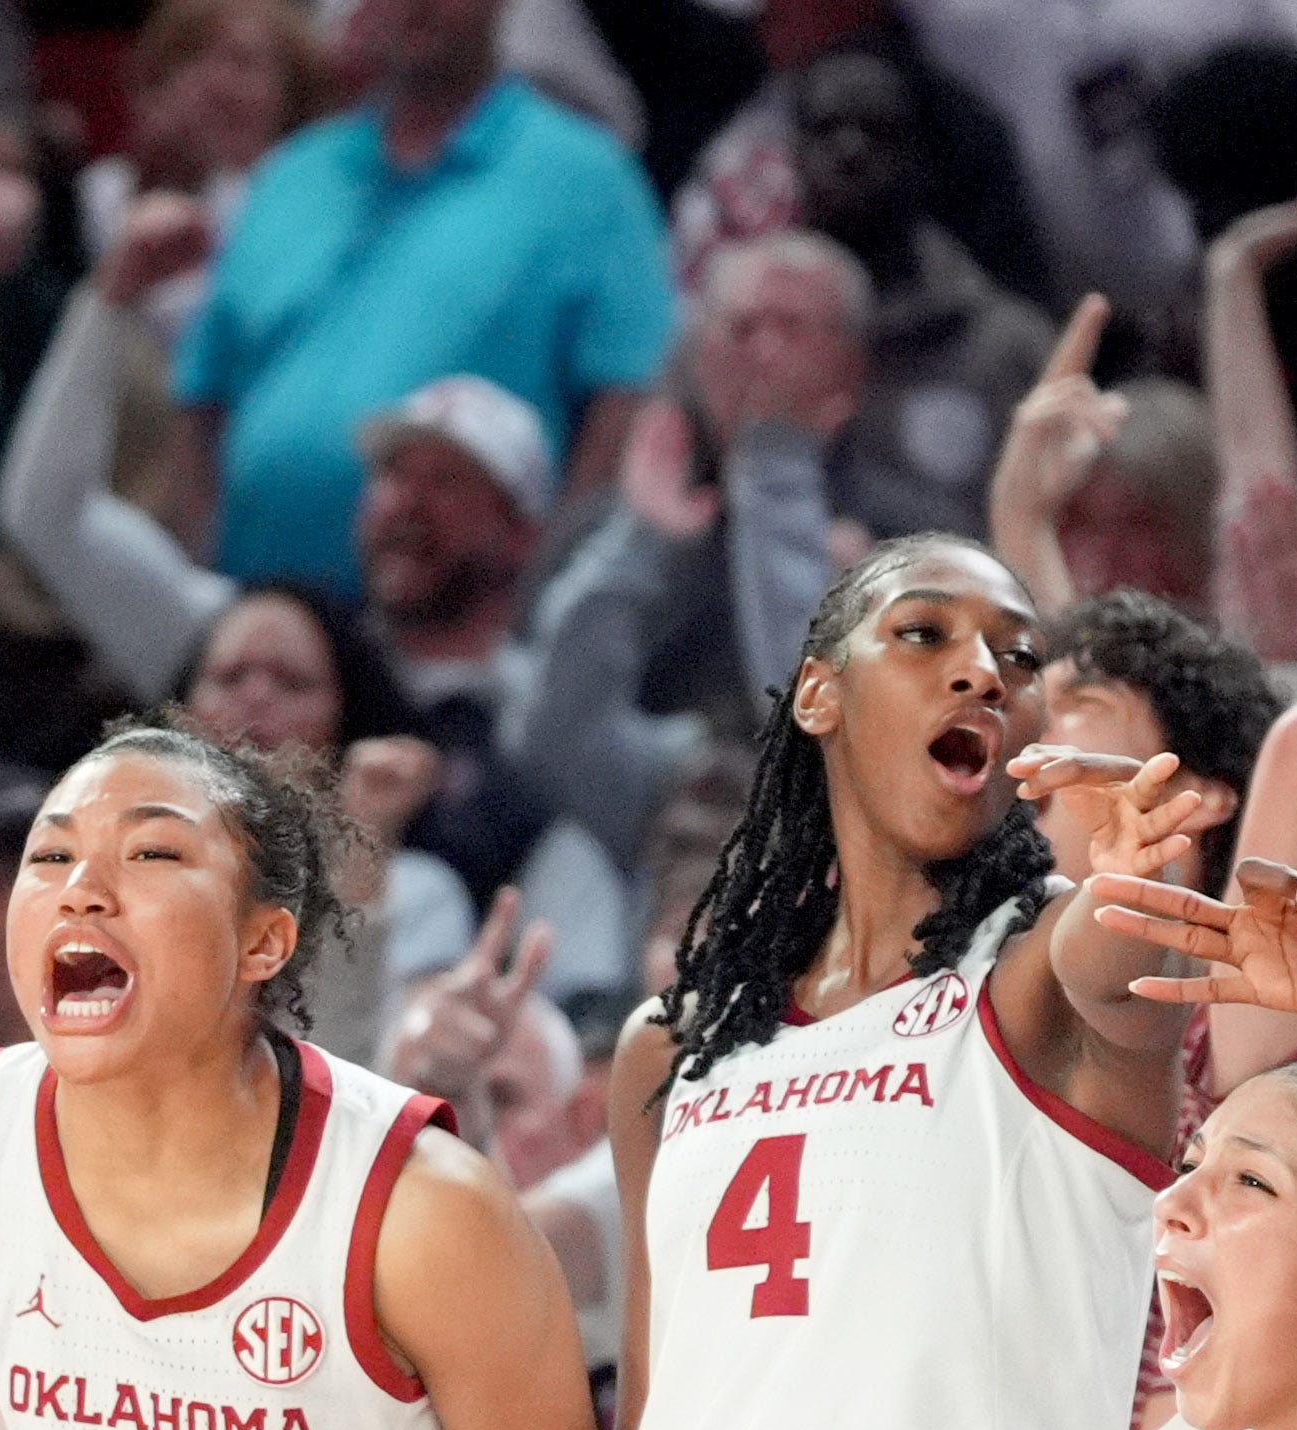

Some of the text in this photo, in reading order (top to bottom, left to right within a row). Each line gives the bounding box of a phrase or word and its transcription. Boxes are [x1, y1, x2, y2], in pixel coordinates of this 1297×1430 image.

[893, 974, 969, 1037] SEC
[664, 1062, 935, 1143] OKLAHOMA
[706, 1133, 812, 1319] 4
[233, 1297, 324, 1384] SEC
